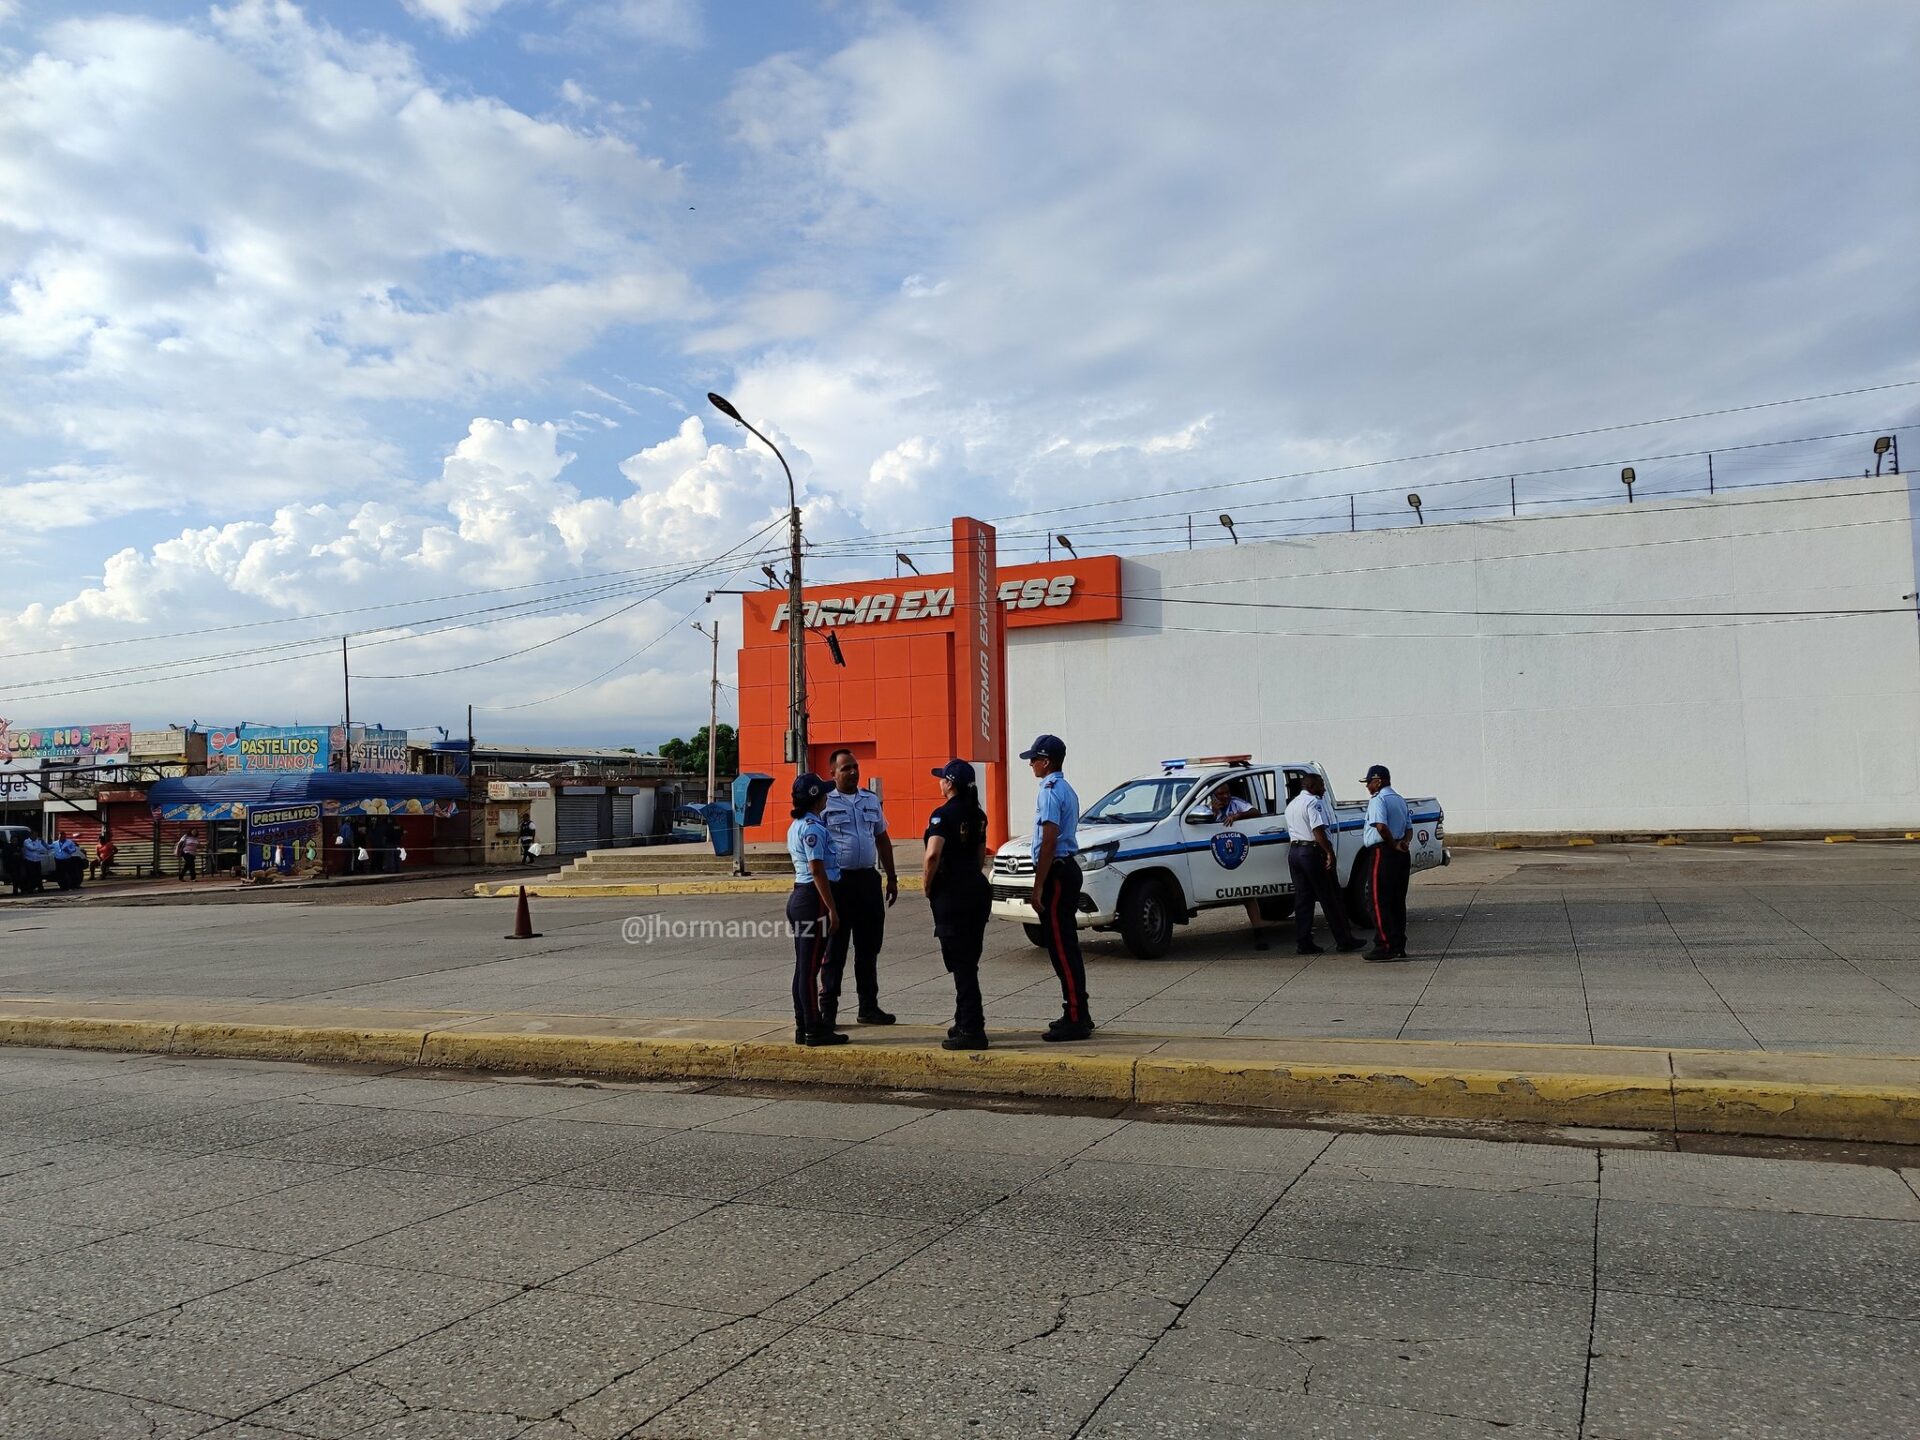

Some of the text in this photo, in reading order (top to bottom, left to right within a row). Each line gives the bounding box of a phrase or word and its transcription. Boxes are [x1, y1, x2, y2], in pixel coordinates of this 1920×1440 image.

[771, 575, 1076, 631] FARMA EXESS
[978, 528, 990, 742] FARMA EXPRESS
[8, 728, 91, 751] ZONA KIDS
[241, 738, 319, 754] PASTELITOS
[227, 754, 242, 769] EL
[253, 808, 317, 824] PASTELITOS
[1216, 883, 1295, 899] CUADRANTE
